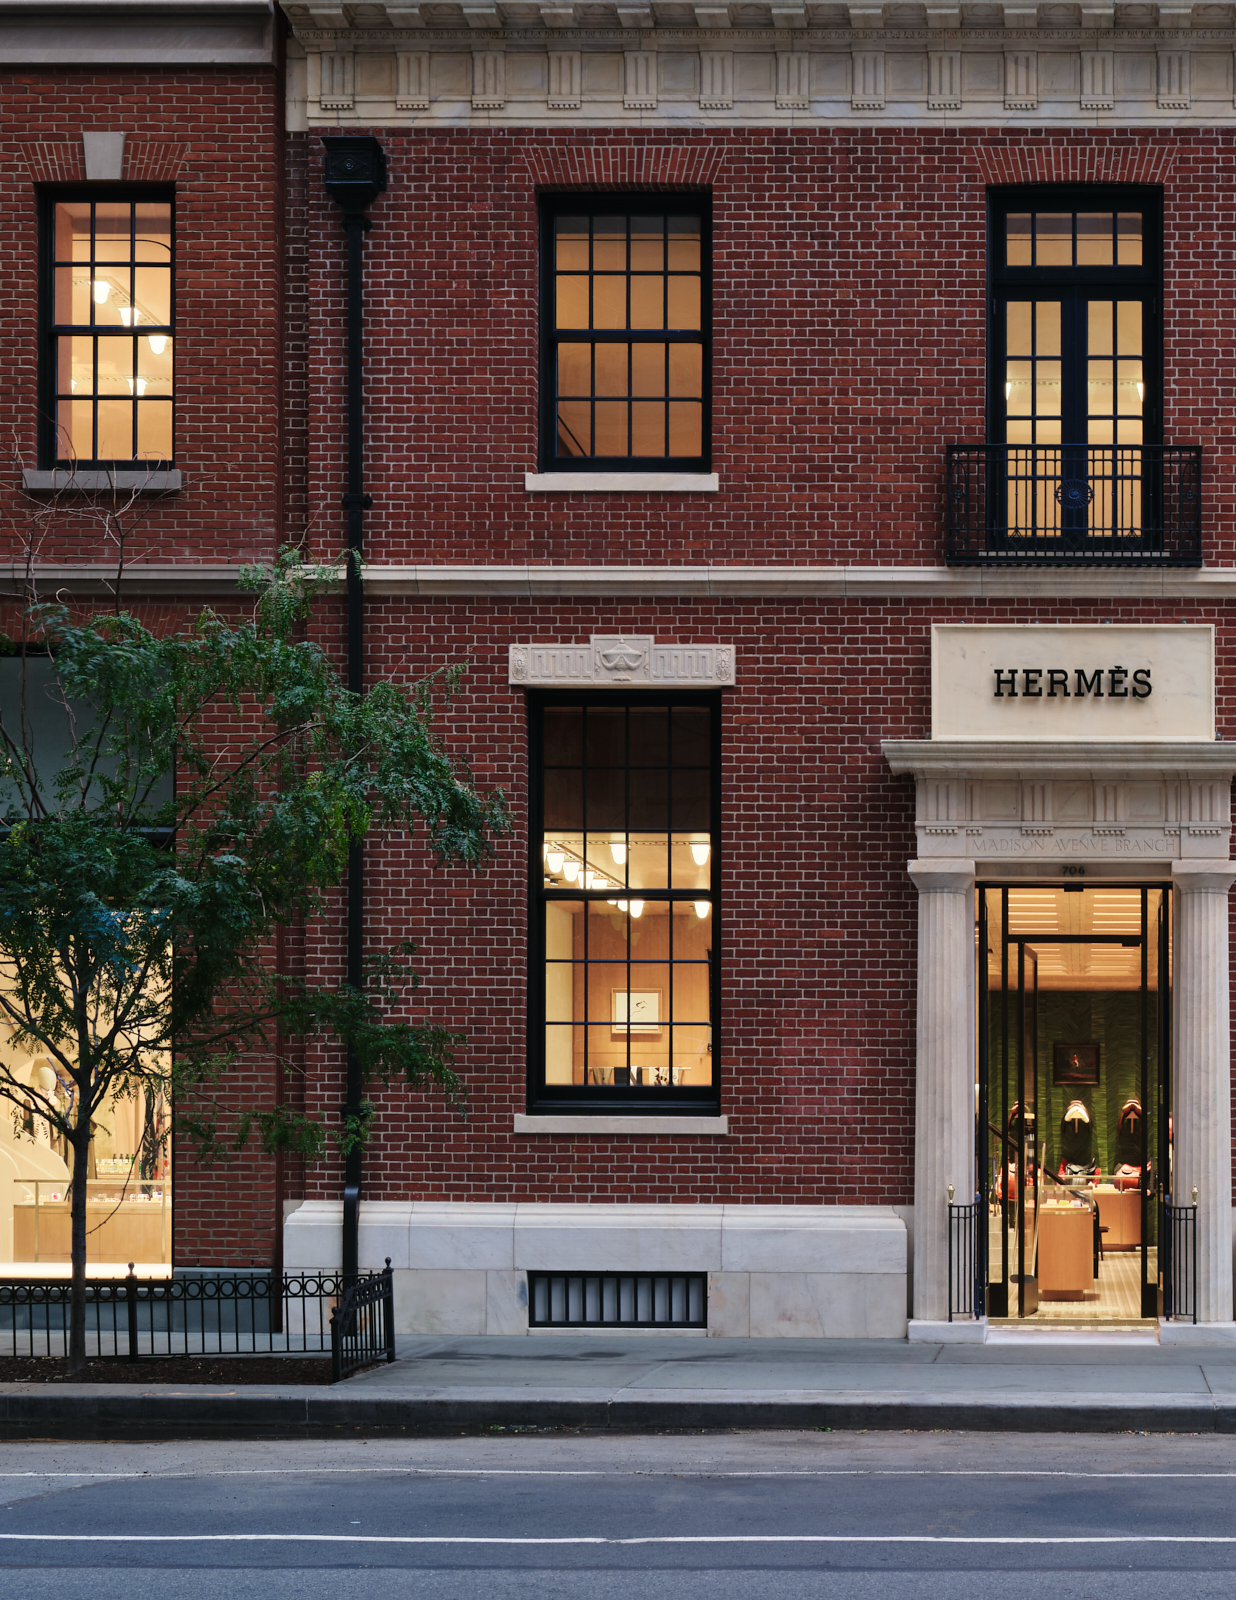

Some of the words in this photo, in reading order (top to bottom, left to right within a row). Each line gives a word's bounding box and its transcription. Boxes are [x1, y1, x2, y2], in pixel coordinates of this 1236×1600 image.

[994, 666, 1152, 698] HERMÈS
[972, 838, 1045, 852] MADISON
[1115, 838, 1175, 852] BRANCH
[1062, 866, 1085, 875] 706
